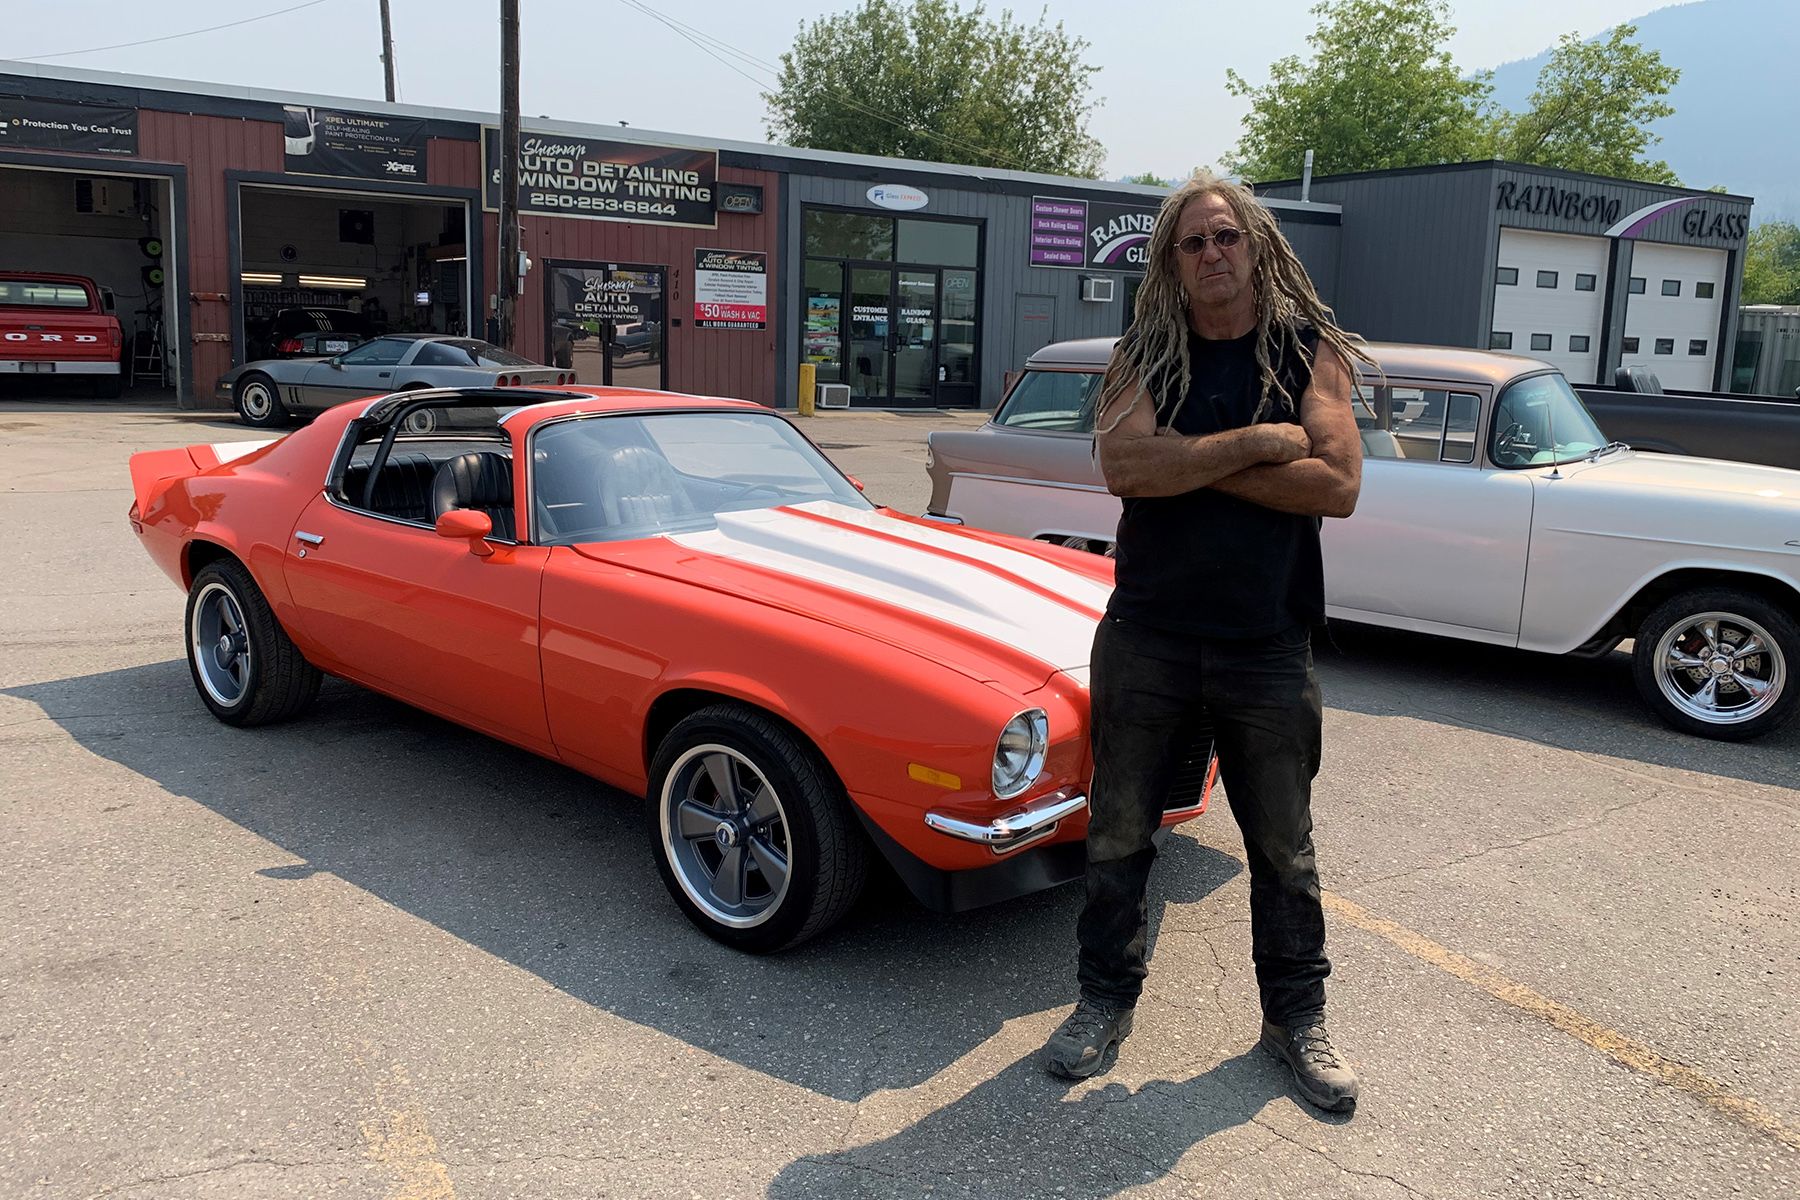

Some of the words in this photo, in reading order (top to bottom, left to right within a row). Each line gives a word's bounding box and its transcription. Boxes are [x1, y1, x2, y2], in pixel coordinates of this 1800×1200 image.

[22, 118, 68, 130] Protection
[71, 123, 88, 132] You
[90, 125, 108, 133] Can
[111, 126, 132, 135] Trust
[325, 126, 370, 134] SELF-HEALING
[345, 132, 384, 141] PROTECTION
[521, 138, 586, 160] Shuswap
[583, 160, 699, 186] DETAILING
[518, 172, 618, 194] WINDOW
[624, 180, 711, 202] TINTING
[726, 196, 754, 208] OPEN
[1053, 206, 1069, 214] Shower
[1497, 181, 1621, 226] RAINBOW
[1683, 208, 1748, 240] GLASS
[1050, 222, 1066, 230] Railing
[1091, 214, 1154, 247] RAINB
[582, 278, 634, 294] Shuswap
[584, 293, 630, 304] AUTO
[575, 303, 638, 313] DETAILING
[700, 304, 719, 318] $50
[853, 306, 888, 314] CUSTOMER
[721, 309, 740, 318] WASH
[748, 311, 760, 320] VAC
[5, 333, 97, 342] ORD
